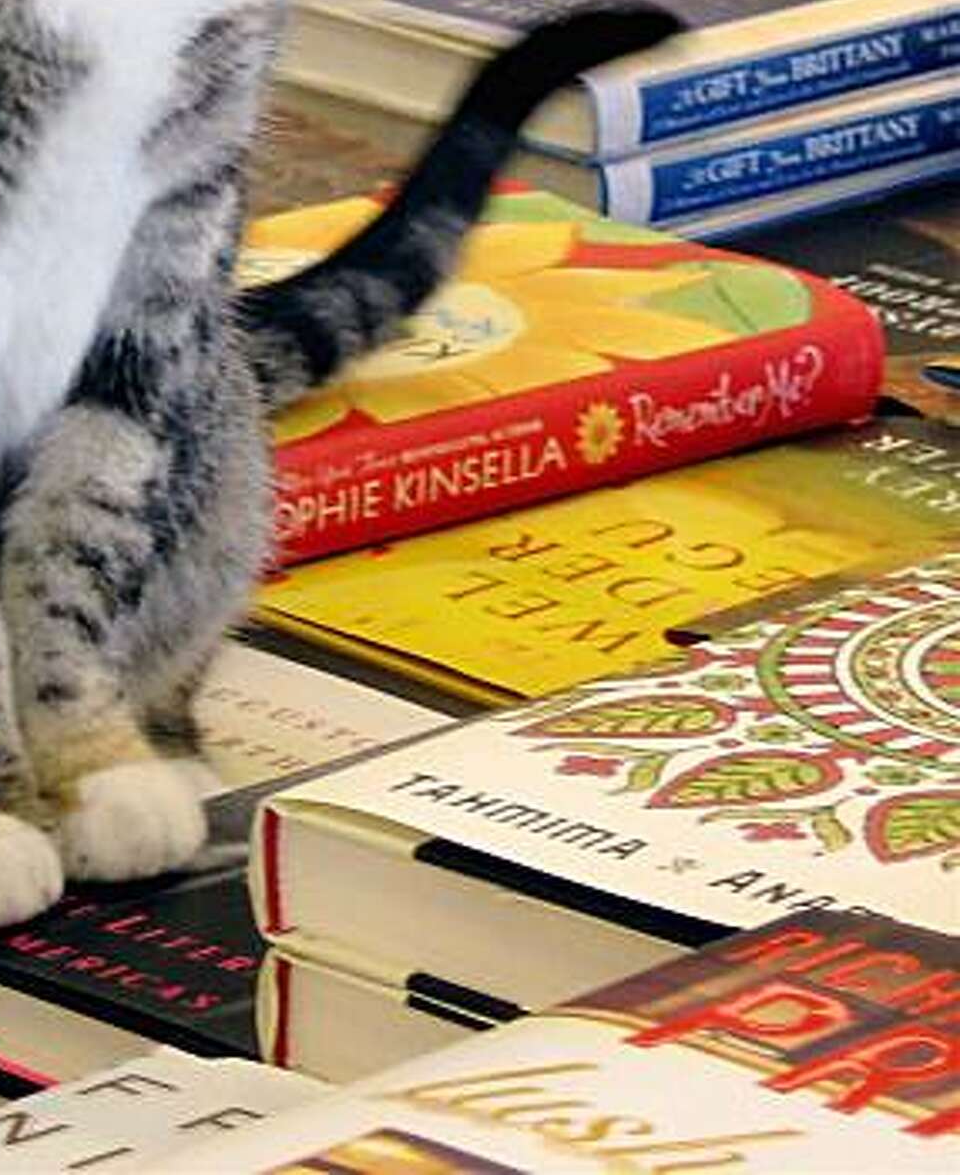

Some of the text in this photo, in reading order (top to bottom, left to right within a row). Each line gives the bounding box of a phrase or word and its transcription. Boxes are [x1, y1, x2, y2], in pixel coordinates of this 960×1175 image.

[790, 31, 908, 81] BRITTANY
[273, 479, 384, 539] OPHIE
[393, 436, 569, 512] KINSELLA
[489, 533, 696, 610] DER
[591, 518, 816, 593] EGU
[444, 571, 640, 654] WEL
[389, 771, 649, 863] TAHMIMA
[5, 933, 222, 1010] MERICAS
[98, 913, 258, 972] LITER
[727, 925, 960, 1022] RICH
[622, 982, 960, 1138] PR
